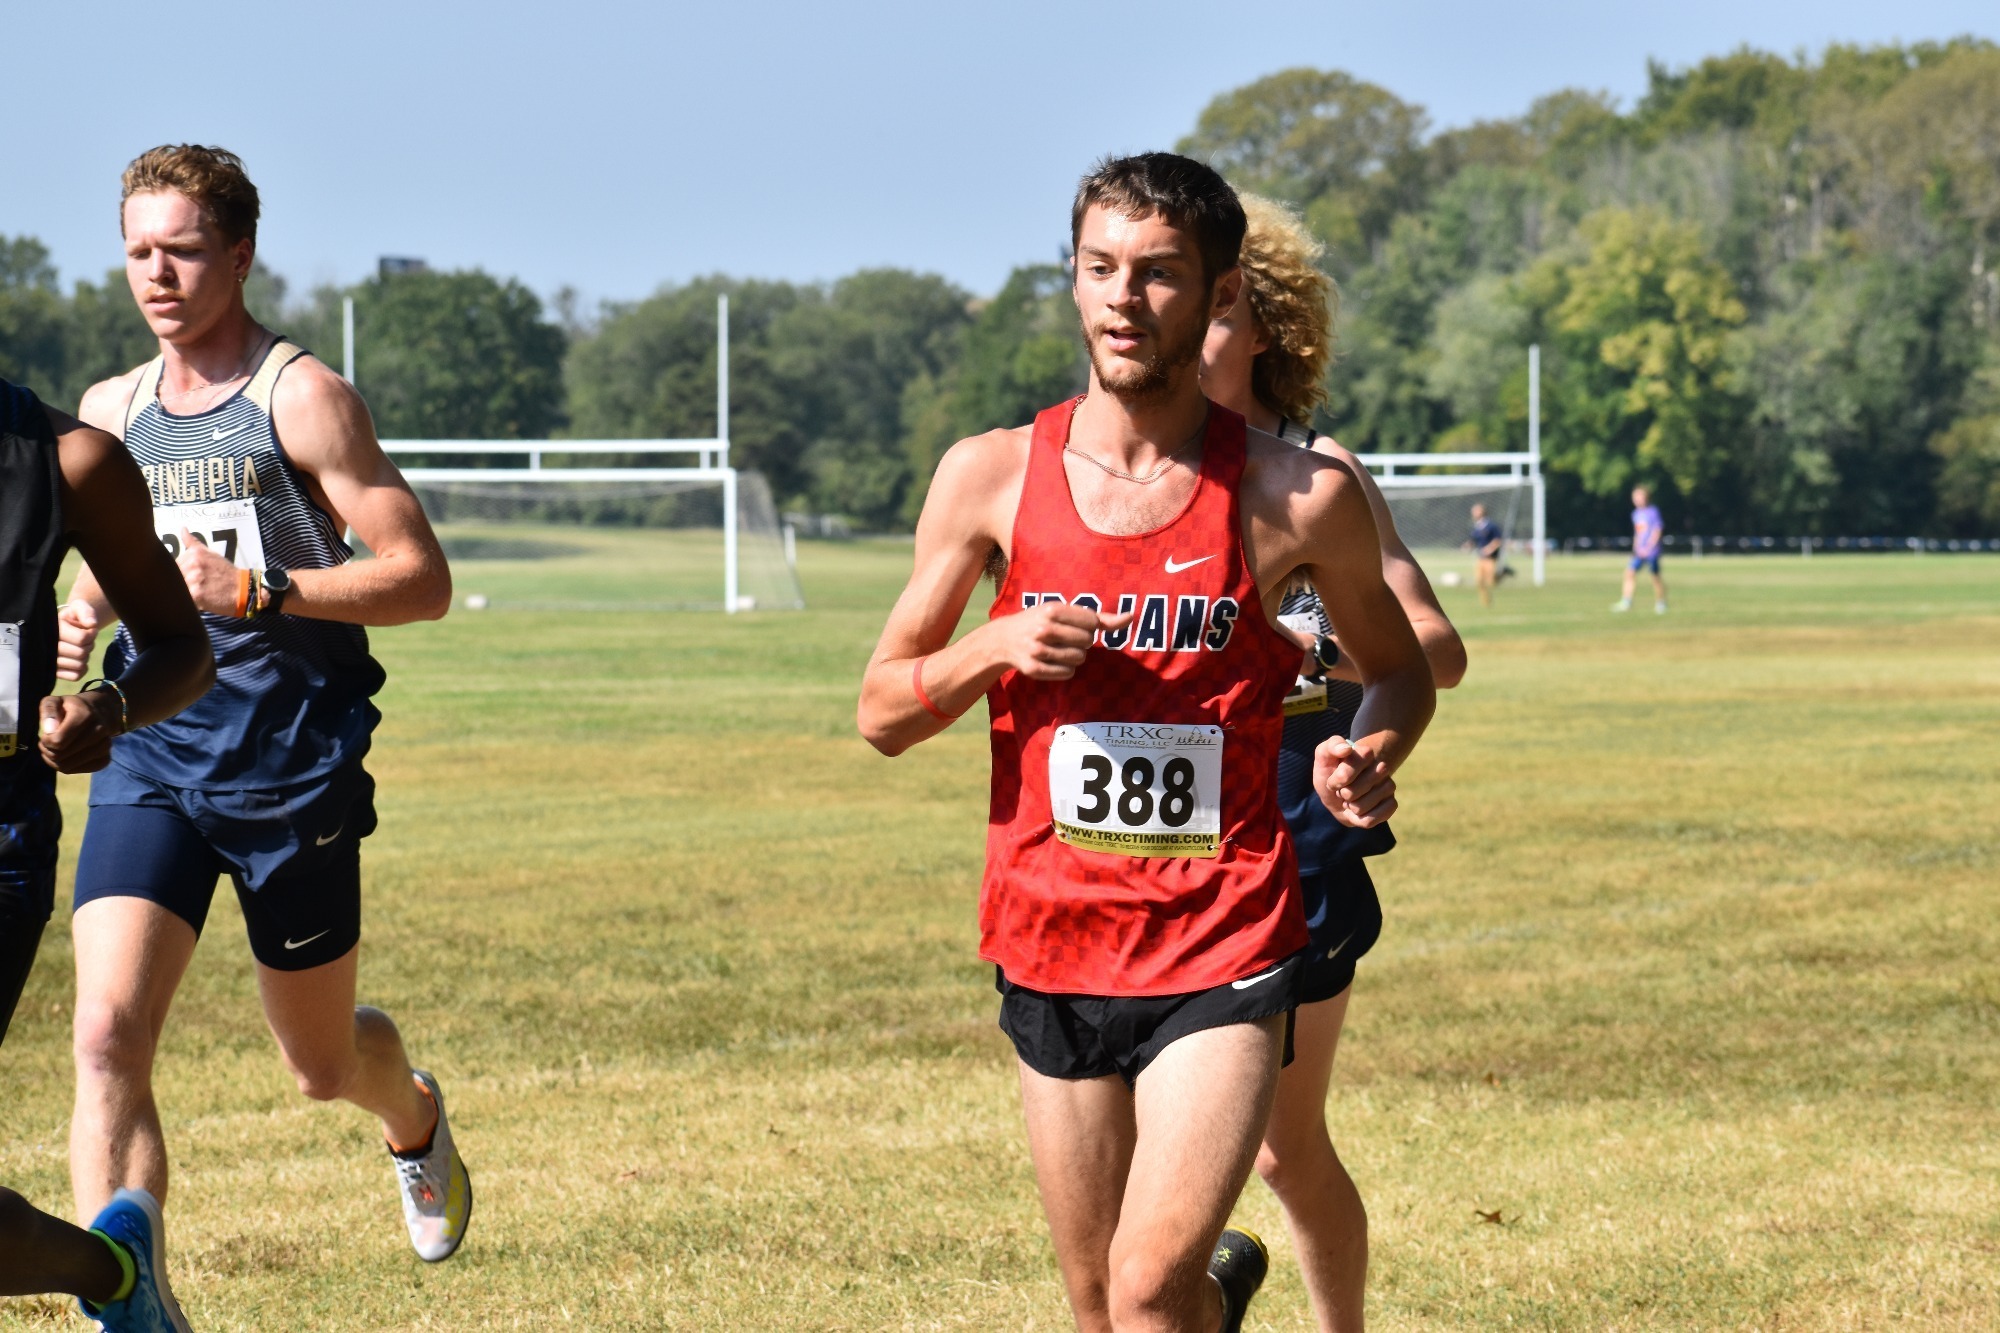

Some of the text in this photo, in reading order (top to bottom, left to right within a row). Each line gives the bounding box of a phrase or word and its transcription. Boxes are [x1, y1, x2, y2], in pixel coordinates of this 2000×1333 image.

[141, 455, 262, 506] RINCIPIA
[1100, 725, 1174, 740] TRXC
[1077, 754, 1195, 827] 388
[1060, 822, 1214, 844] WWW.TRXCTIMING.COM
